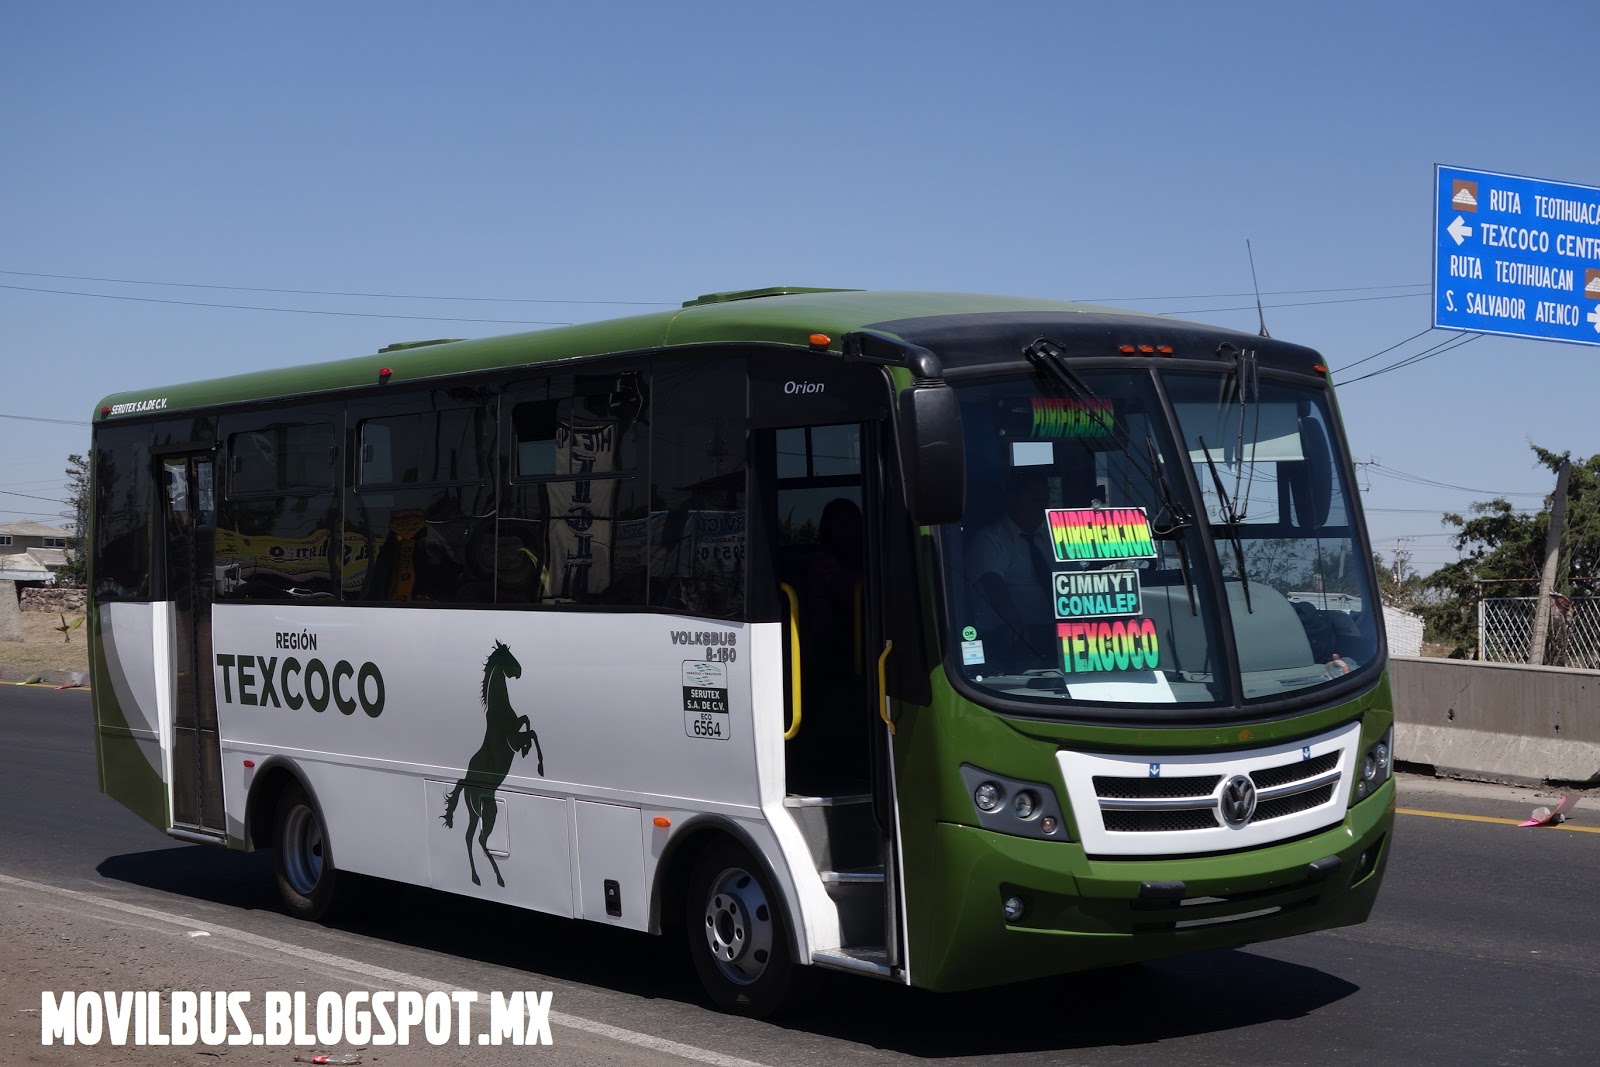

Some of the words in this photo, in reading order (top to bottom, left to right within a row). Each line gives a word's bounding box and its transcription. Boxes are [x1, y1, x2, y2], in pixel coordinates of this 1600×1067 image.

[1490, 189, 1522, 215] RUTA
[1480, 222, 1550, 253] TEXCOCO
[1450, 254, 1483, 280] RUTA
[1495, 260, 1574, 292] TEOTIHUACAN
[1445, 289, 1458, 312] S.
[1466, 292, 1526, 320] SALVADOR
[1535, 301, 1580, 327] ATENCO
[784, 380, 825, 394] Orion
[110, 402, 137, 415] SERUTEX
[1050, 509, 1155, 559] PURIFICACION
[1056, 573, 1136, 595] CIMMYT
[1057, 593, 1138, 617] CONALEP
[275, 628, 318, 650] REGIÓN
[670, 630, 737, 646] VOLKSBUS
[1056, 618, 1160, 673] TEXCOCO
[705, 647, 737, 662] 8-150
[216, 653, 386, 719] TEXCOCO
[690, 689, 720, 699] SERUTEX
[687, 700, 700, 709] S.A.
[701, 701, 711, 710] DE
[712, 701, 725, 711] C.V.
[694, 720, 721, 737] 6564
